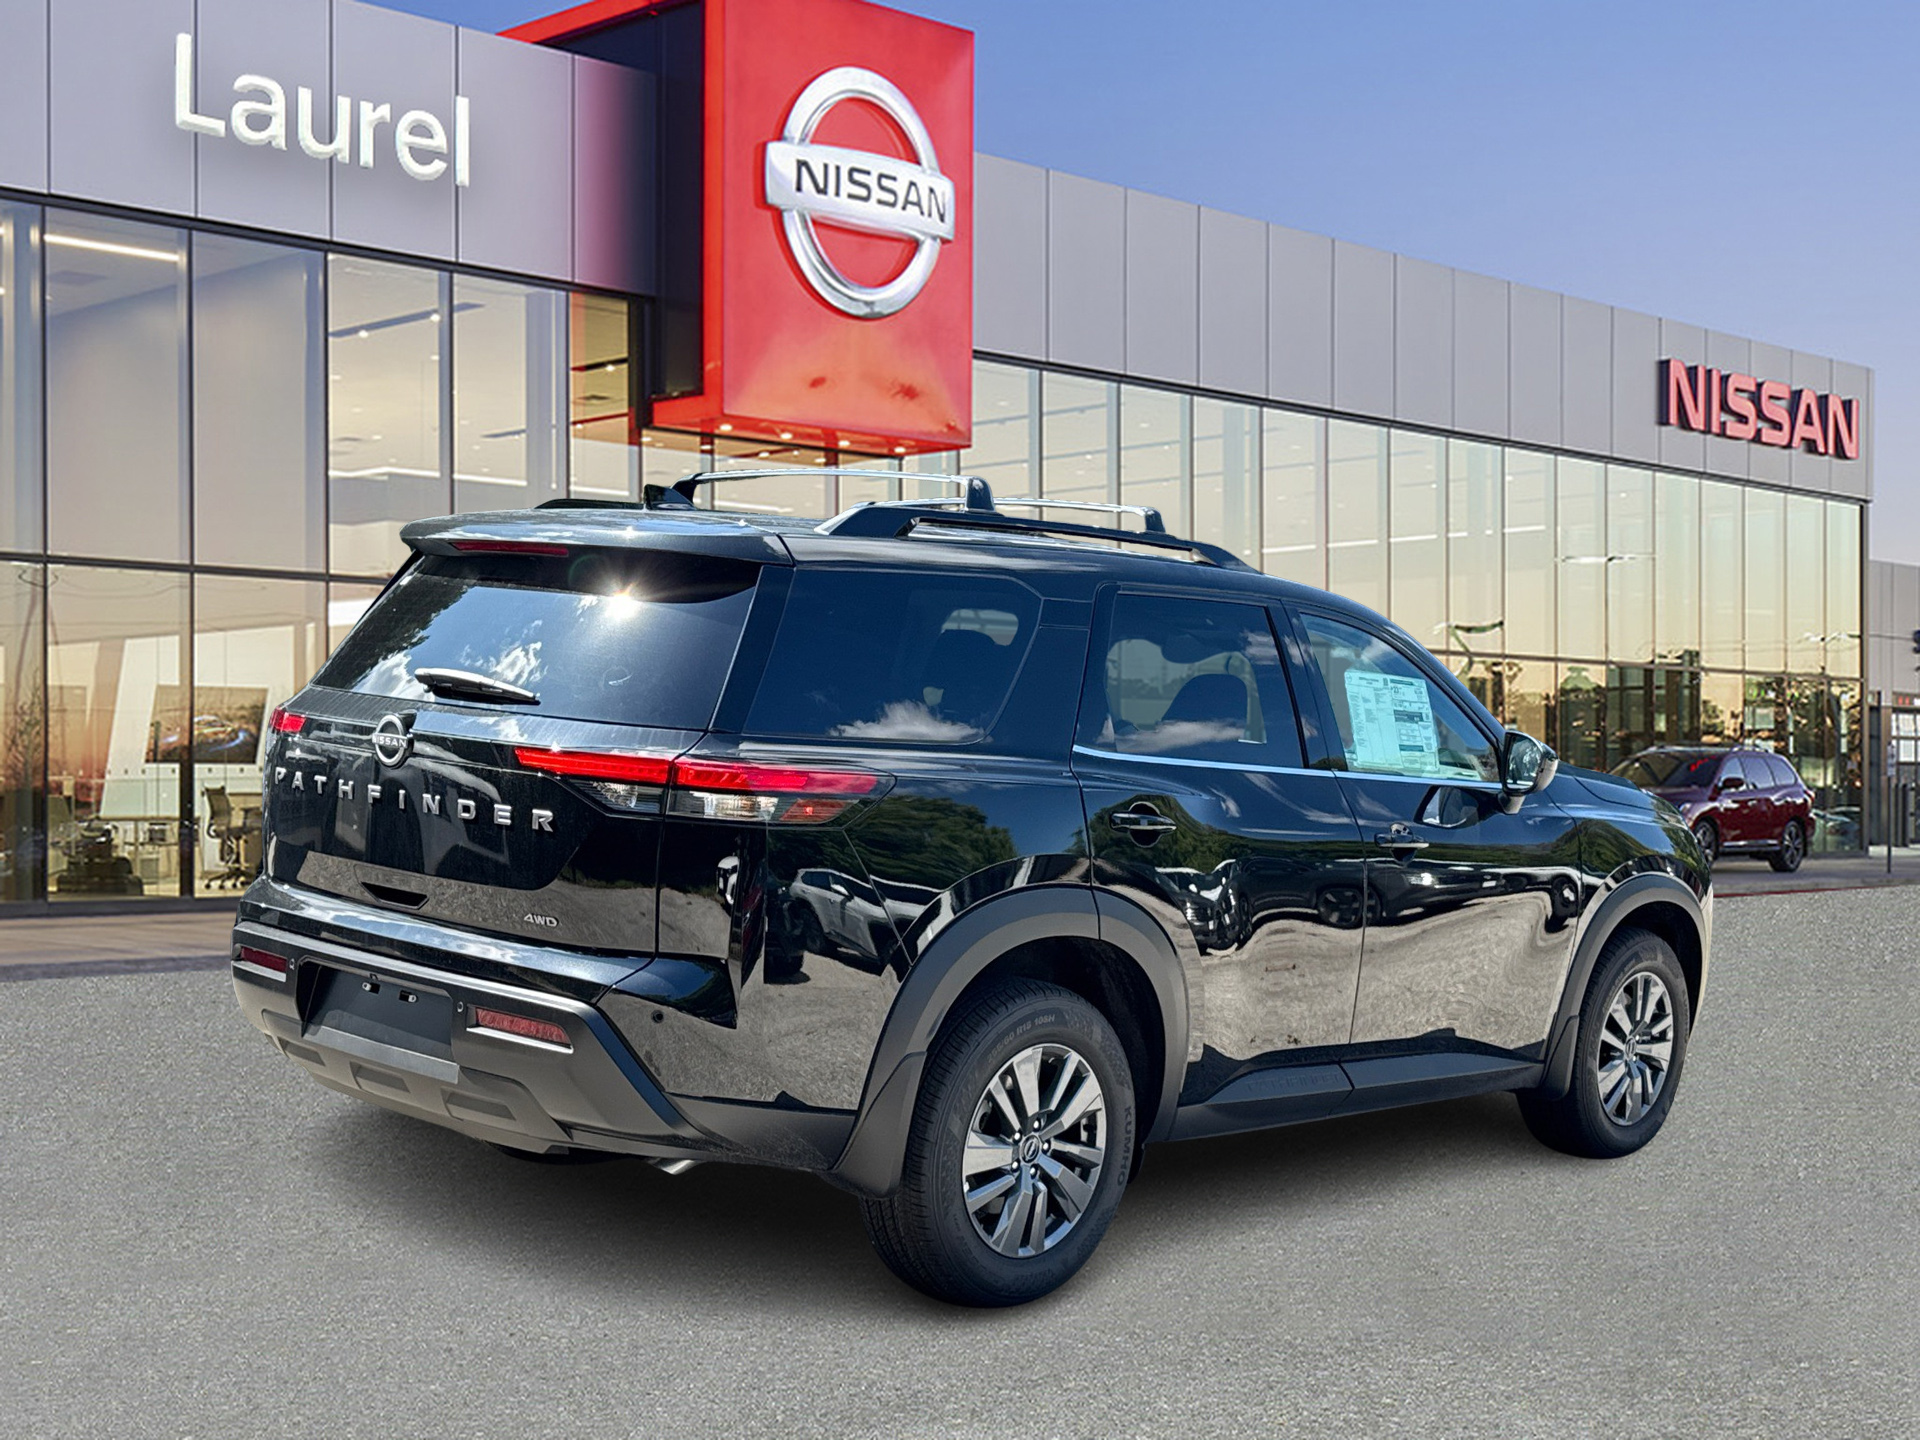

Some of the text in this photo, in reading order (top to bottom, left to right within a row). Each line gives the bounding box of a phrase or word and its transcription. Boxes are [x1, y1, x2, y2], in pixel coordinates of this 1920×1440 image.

[175, 32, 469, 187] Laurel
[795, 159, 946, 223] NISSAN
[1659, 358, 1860, 459] NISSAN
[373, 735, 407, 748] NISSAN
[274, 766, 554, 833] PATHFINDER
[523, 913, 558, 927] 4WD
[1117, 1105, 1132, 1187] KUMHO
